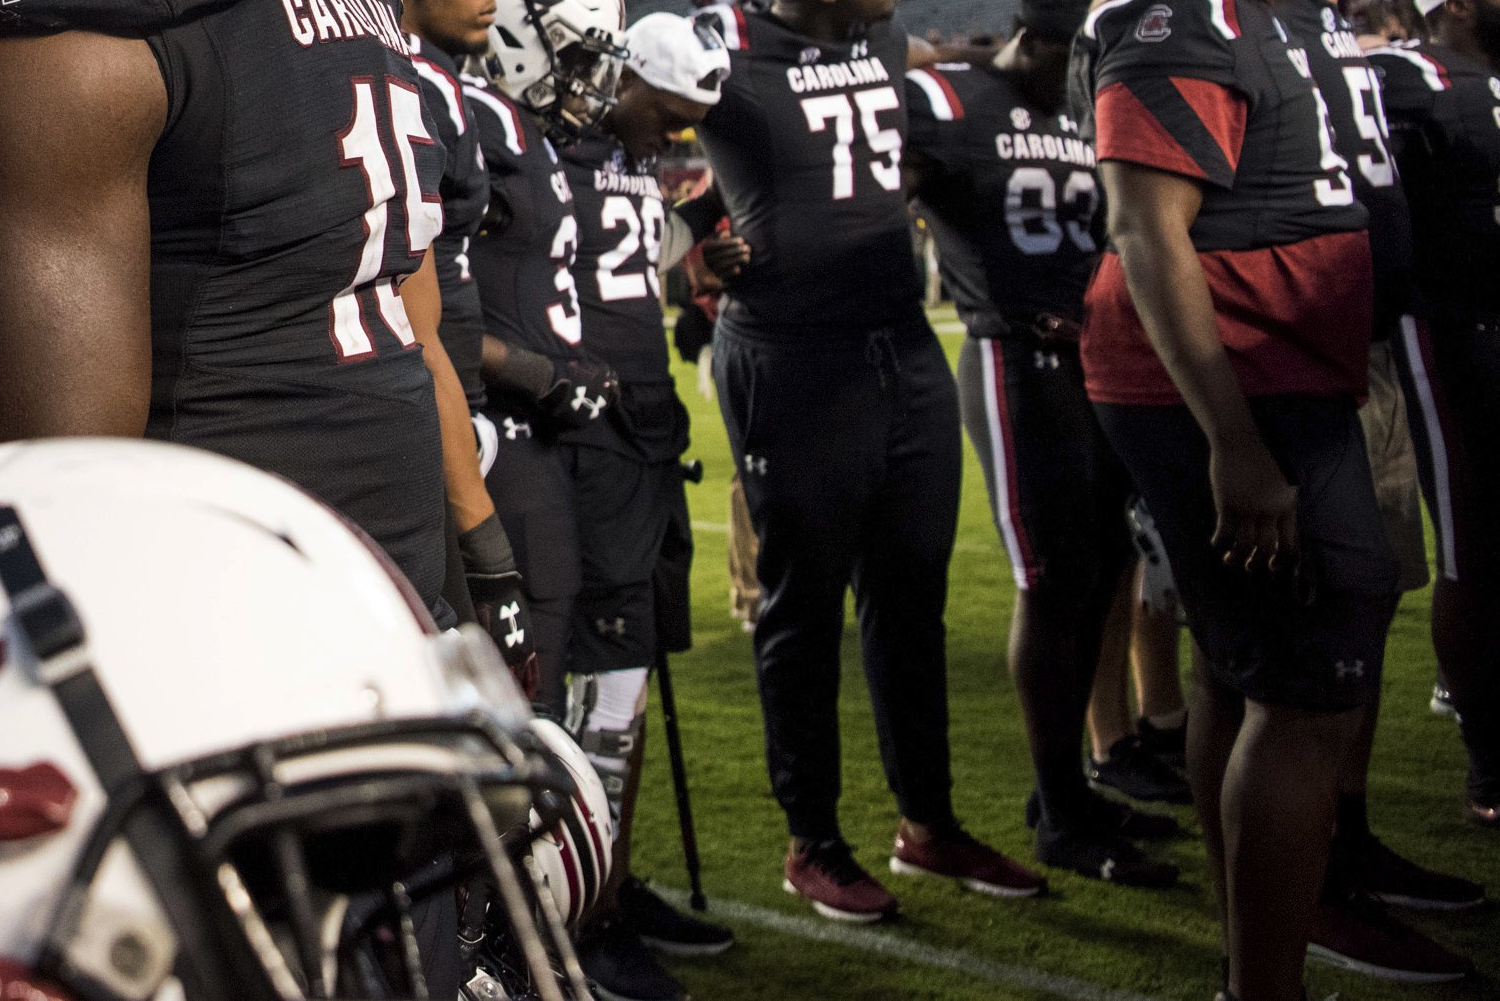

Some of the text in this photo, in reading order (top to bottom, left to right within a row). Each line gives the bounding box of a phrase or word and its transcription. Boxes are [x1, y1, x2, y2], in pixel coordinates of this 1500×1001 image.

[785, 56, 890, 93] CAROLINA
[1342, 66, 1401, 189] 5
[800, 85, 903, 201] 75
[995, 132, 1097, 169] CAROLINA
[328, 73, 445, 364] 15
